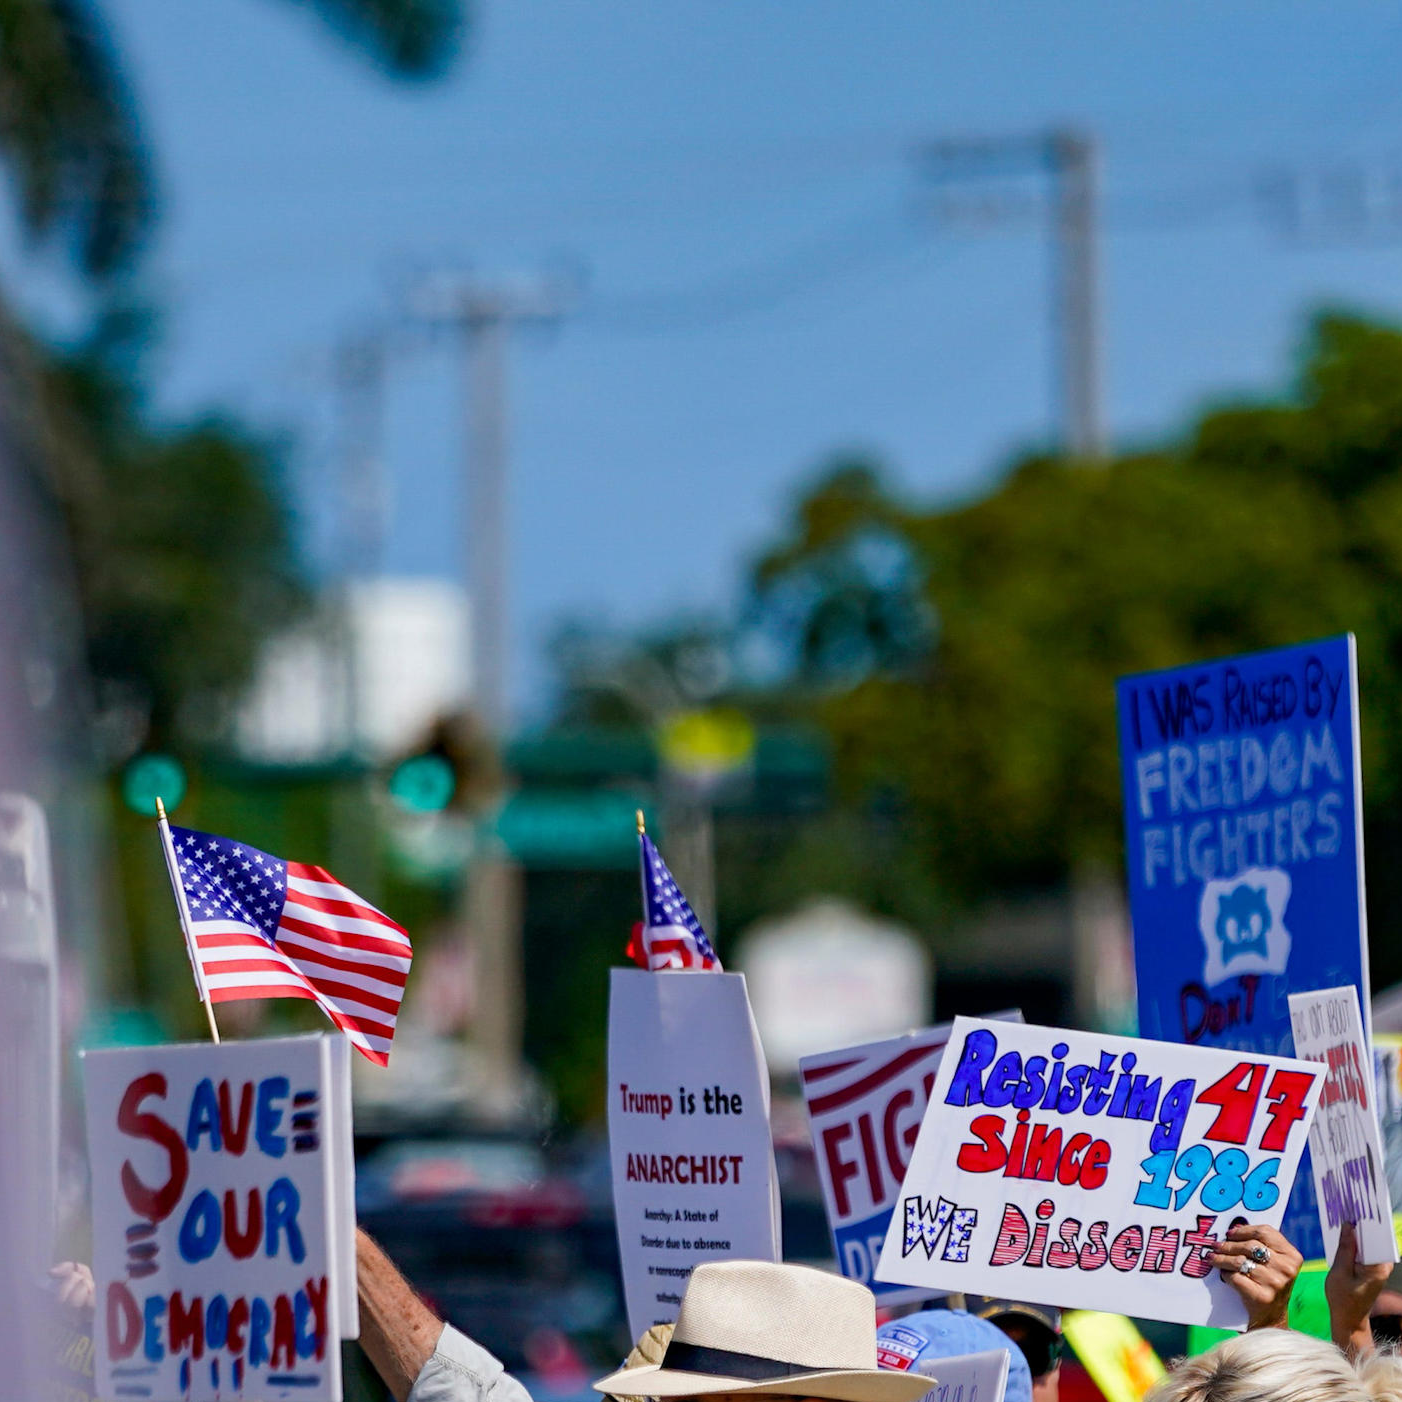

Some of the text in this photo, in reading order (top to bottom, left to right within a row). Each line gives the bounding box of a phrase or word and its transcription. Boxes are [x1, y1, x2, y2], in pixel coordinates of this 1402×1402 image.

[1132, 655, 1343, 748] I WAS RAISED BY
[1134, 721, 1345, 820] FREEDOM
[1141, 792, 1344, 888] FIGHTERS
[619, 1083, 743, 1120] Trump is the
[944, 1028, 1316, 1154] Resisting 47
[116, 1071, 290, 1223] SAVE
[626, 1152, 743, 1186] ANARCHIST
[1133, 1144, 1280, 1212] 1986
[178, 1176, 306, 1265] OUR
[666, 1237, 680, 1250] due
[683, 1238, 692, 1250] to
[694, 1237, 732, 1251] absence
[675, 1209, 682, 1221] A
[684, 1209, 707, 1222] State
[709, 1209, 719, 1222] of
[902, 1195, 978, 1263] WE
[106, 1276, 329, 1371] DEMOCRACY
